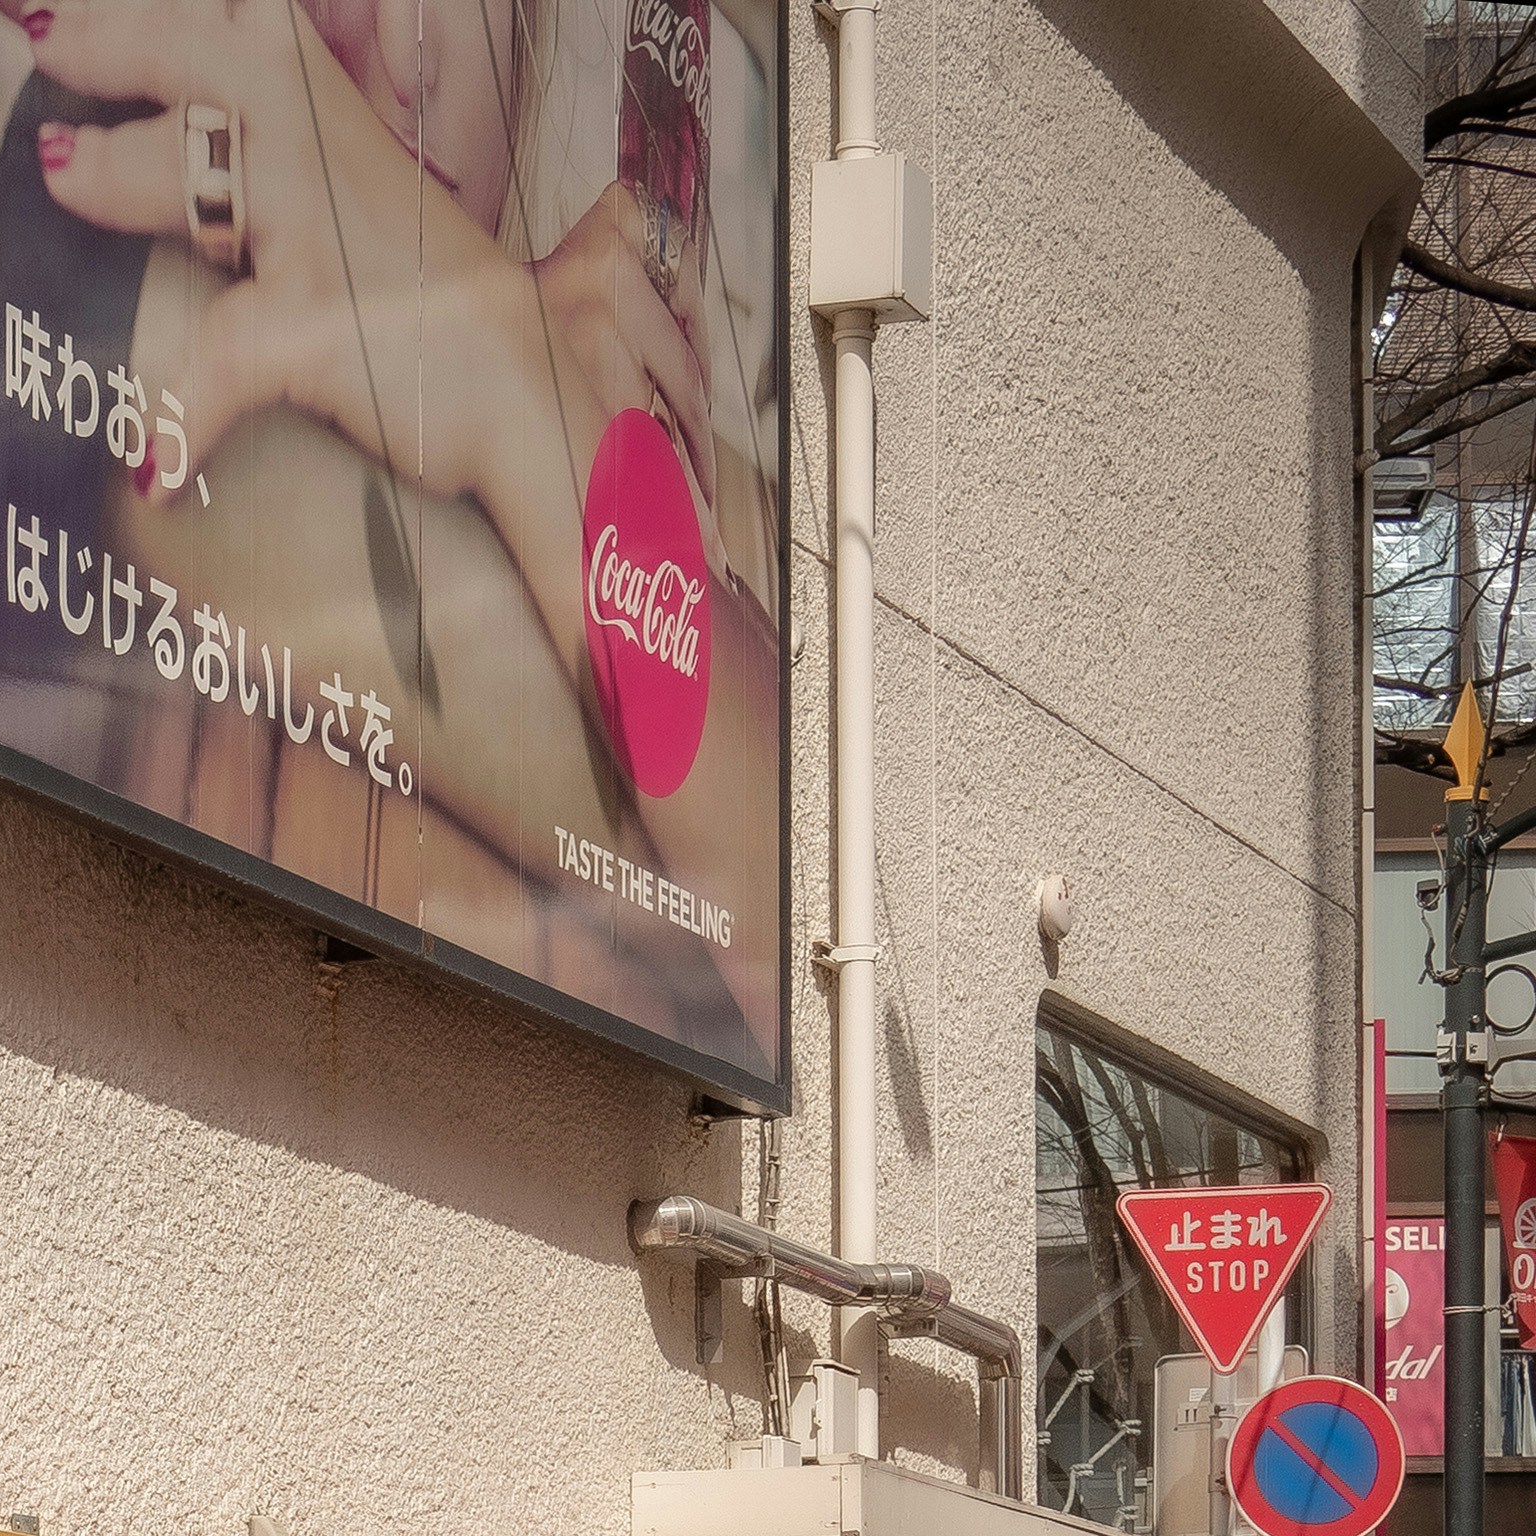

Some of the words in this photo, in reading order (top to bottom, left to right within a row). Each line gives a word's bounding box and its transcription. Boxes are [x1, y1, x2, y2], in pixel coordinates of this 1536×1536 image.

[4, 301, 211, 508] 味わおう、
[6, 503, 413, 797] はじけるおいしさを。
[588, 523, 706, 679] Coca-Cola
[554, 825, 614, 893] TASTE
[617, 855, 654, 913] THE
[658, 878, 732, 949] FEELING
[1164, 1208, 1288, 1252] 止まれ
[1186, 1260, 1270, 1295] STOP
